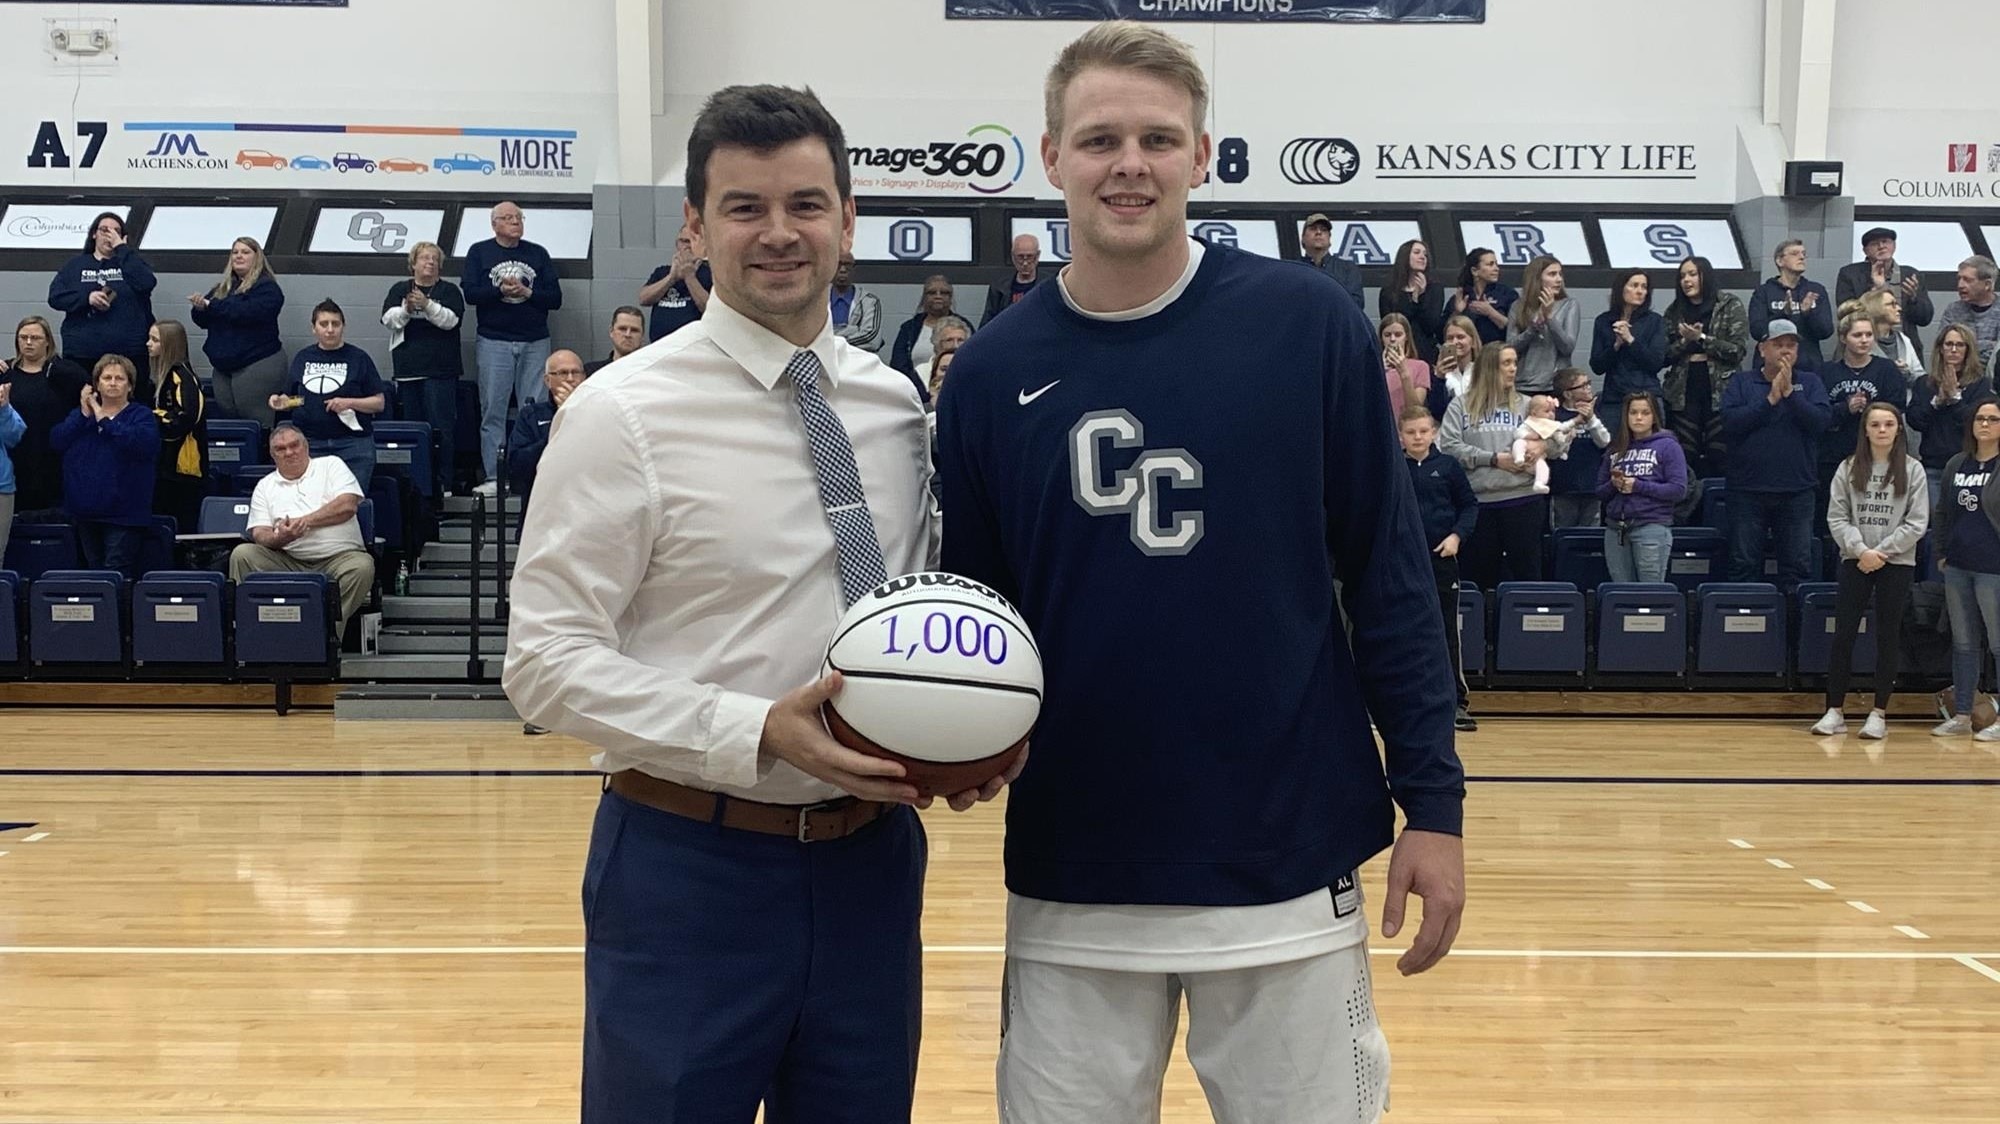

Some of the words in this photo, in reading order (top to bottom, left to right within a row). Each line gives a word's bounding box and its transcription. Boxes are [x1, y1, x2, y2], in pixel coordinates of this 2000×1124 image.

[1138, 0, 1293, 13] CHAMPIONS
[127, 158, 229, 170] MACHENS.COM
[500, 139, 574, 170] MORE
[847, 142, 1006, 177] mage360
[1375, 144, 1517, 171] KANSAS
[1526, 144, 1612, 171] CITY
[1620, 144, 1697, 171] LIFE
[880, 178, 919, 189] Signage
[926, 179, 966, 189] Displays
[347, 211, 408, 253] CC
[1068, 407, 1204, 556] CC
[880, 611, 1008, 666] 1,000
[1337, 875, 1352, 890] XL
